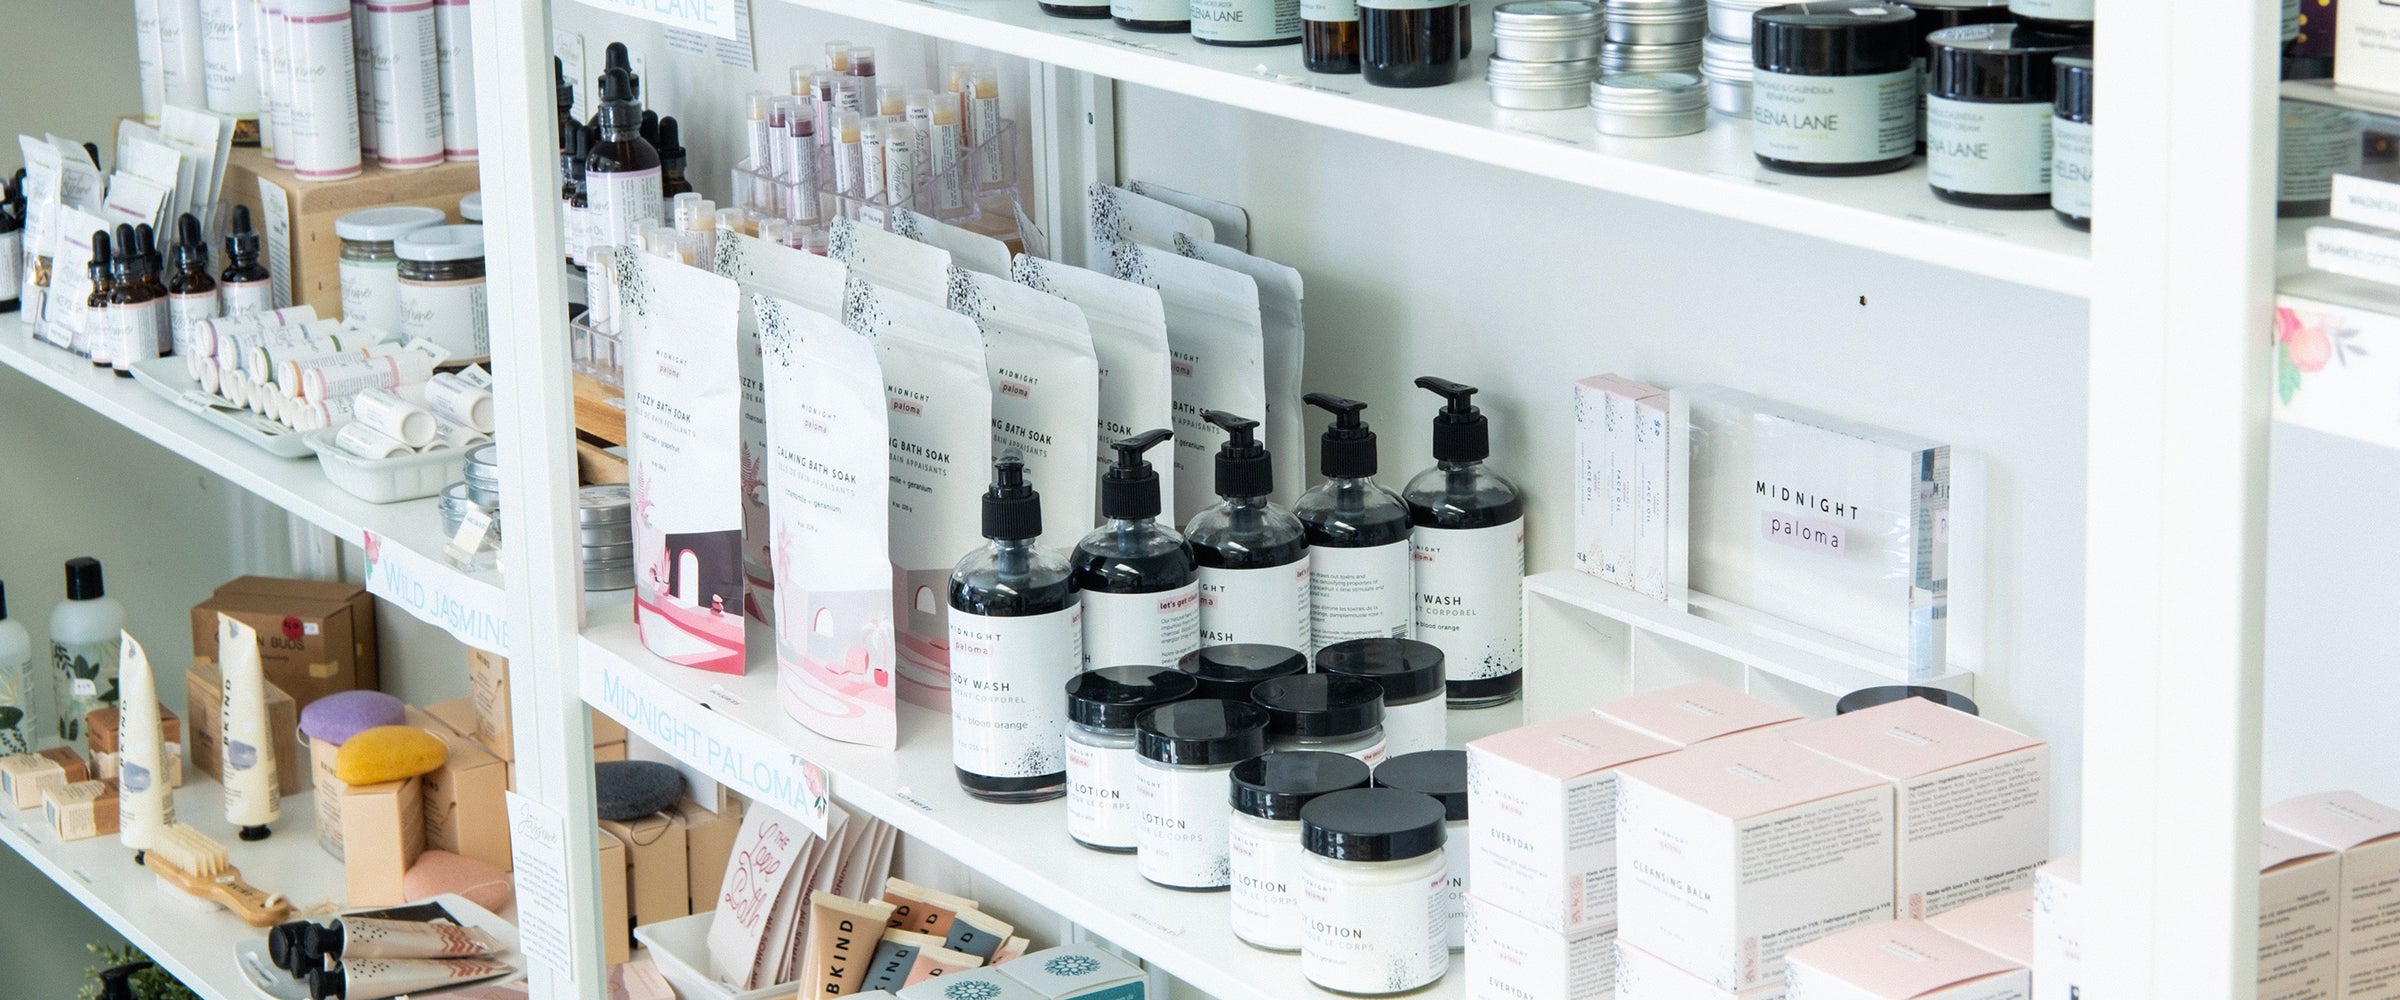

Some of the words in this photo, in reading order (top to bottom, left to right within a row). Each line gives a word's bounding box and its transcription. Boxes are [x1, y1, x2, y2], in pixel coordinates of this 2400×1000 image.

[1213, 9, 1244, 23] LANE
[1793, 113, 1839, 131] LANE
[1948, 142, 1988, 160] LANE
[998, 368, 1039, 385] MIDNIGHT
[888, 385, 930, 403] MIDNIGHT
[1002, 384, 1029, 398] paloma
[637, 392, 654, 407] FIZZY
[656, 401, 672, 415] BATH
[673, 408, 691, 424] SOAK
[801, 403, 837, 422] MIDNIGHT
[893, 400, 921, 416] paloma
[1173, 400, 1196, 415] BATH
[1005, 422, 1026, 438] BATH
[1028, 430, 1052, 446] SOAK
[1107, 421, 1132, 437] SOAK
[901, 439, 922, 457] BATH
[925, 447, 950, 464] SOAK
[777, 445, 807, 467] CALMING
[808, 459, 829, 475] BATH
[832, 468, 857, 484] SOAK
[906, 456, 948, 478] APPAISANTS
[907, 480, 933, 494] geranium
[813, 499, 842, 513] geranium
[1756, 480, 1858, 520] MIDNIGHT
[1771, 518, 1839, 548] paloma
[383, 559, 425, 610] WILD
[430, 591, 509, 650] JASMINE
[1160, 600, 1176, 610] let's
[1177, 597, 1188, 608] get
[1423, 593, 1462, 606] WASH
[1426, 607, 1477, 617] CORPOREL
[1420, 620, 1437, 630] blood
[1437, 622, 1461, 632] orange
[270, 636, 305, 651] BUDS
[1200, 629, 1233, 642] WASH
[955, 641, 989, 656] paloma
[951, 671, 969, 686] ODY
[972, 679, 1011, 692] WASH
[975, 693, 1026, 704] CORPOREL
[968, 716, 991, 729] blood
[994, 719, 1029, 731] orange
[603, 667, 702, 758] MIDNIGHT
[707, 740, 810, 817] PALOMA
[1074, 782, 1120, 800] LOTION
[1098, 800, 1131, 810] CORPS
[1141, 810, 1186, 830] LOTION
[775, 830, 791, 852] THE
[1166, 832, 1203, 842] CORPS
[1491, 828, 1534, 853] EVERYDAY
[1238, 873, 1287, 893] LOTION
[1633, 859, 1683, 890] CLEANSING
[1686, 884, 1712, 902] BALM
[1263, 894, 1298, 906] CORPS
[1311, 919, 1363, 939] LOTION
[755, 937, 768, 968] SOME
[1338, 940, 1375, 952] CORPS
[826, 918, 854, 995] BKIND
[1488, 976, 1535, 1000] EVERYDAY
